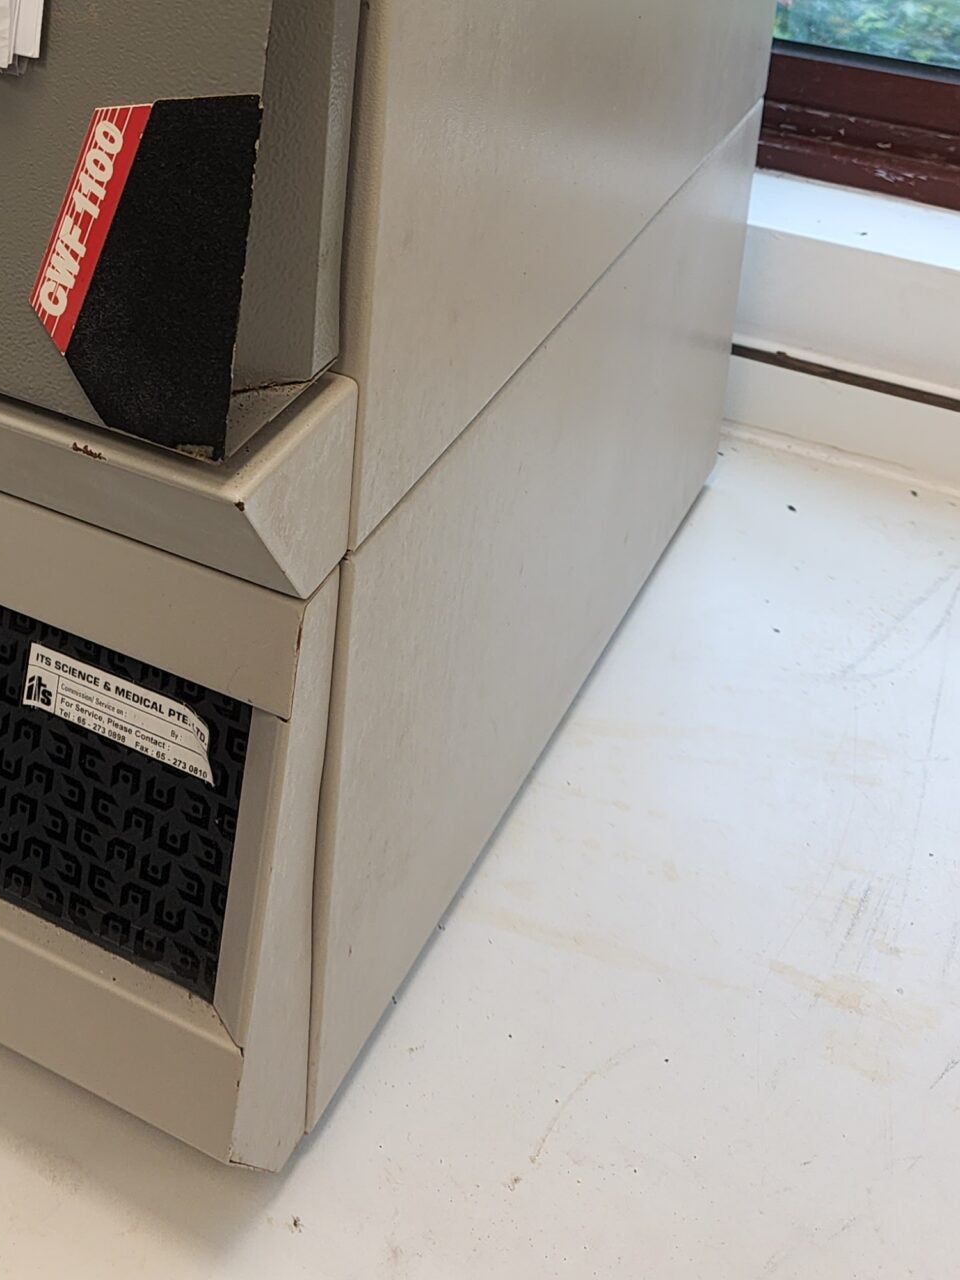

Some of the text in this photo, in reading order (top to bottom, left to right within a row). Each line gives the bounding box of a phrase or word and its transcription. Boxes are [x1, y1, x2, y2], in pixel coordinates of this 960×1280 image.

[36, 653, 52, 667] ITS
[54, 660, 100, 687] SCIENCE
[103, 681, 111, 691] &
[114, 685, 165, 715] MEDICAL
[168, 707, 191, 727] PTE.
[60, 697, 74, 709] For
[107, 717, 133, 739] Please
[77, 716, 86, 727] 65
[93, 722, 107, 735] 273
[173, 757, 187, 770] 273
